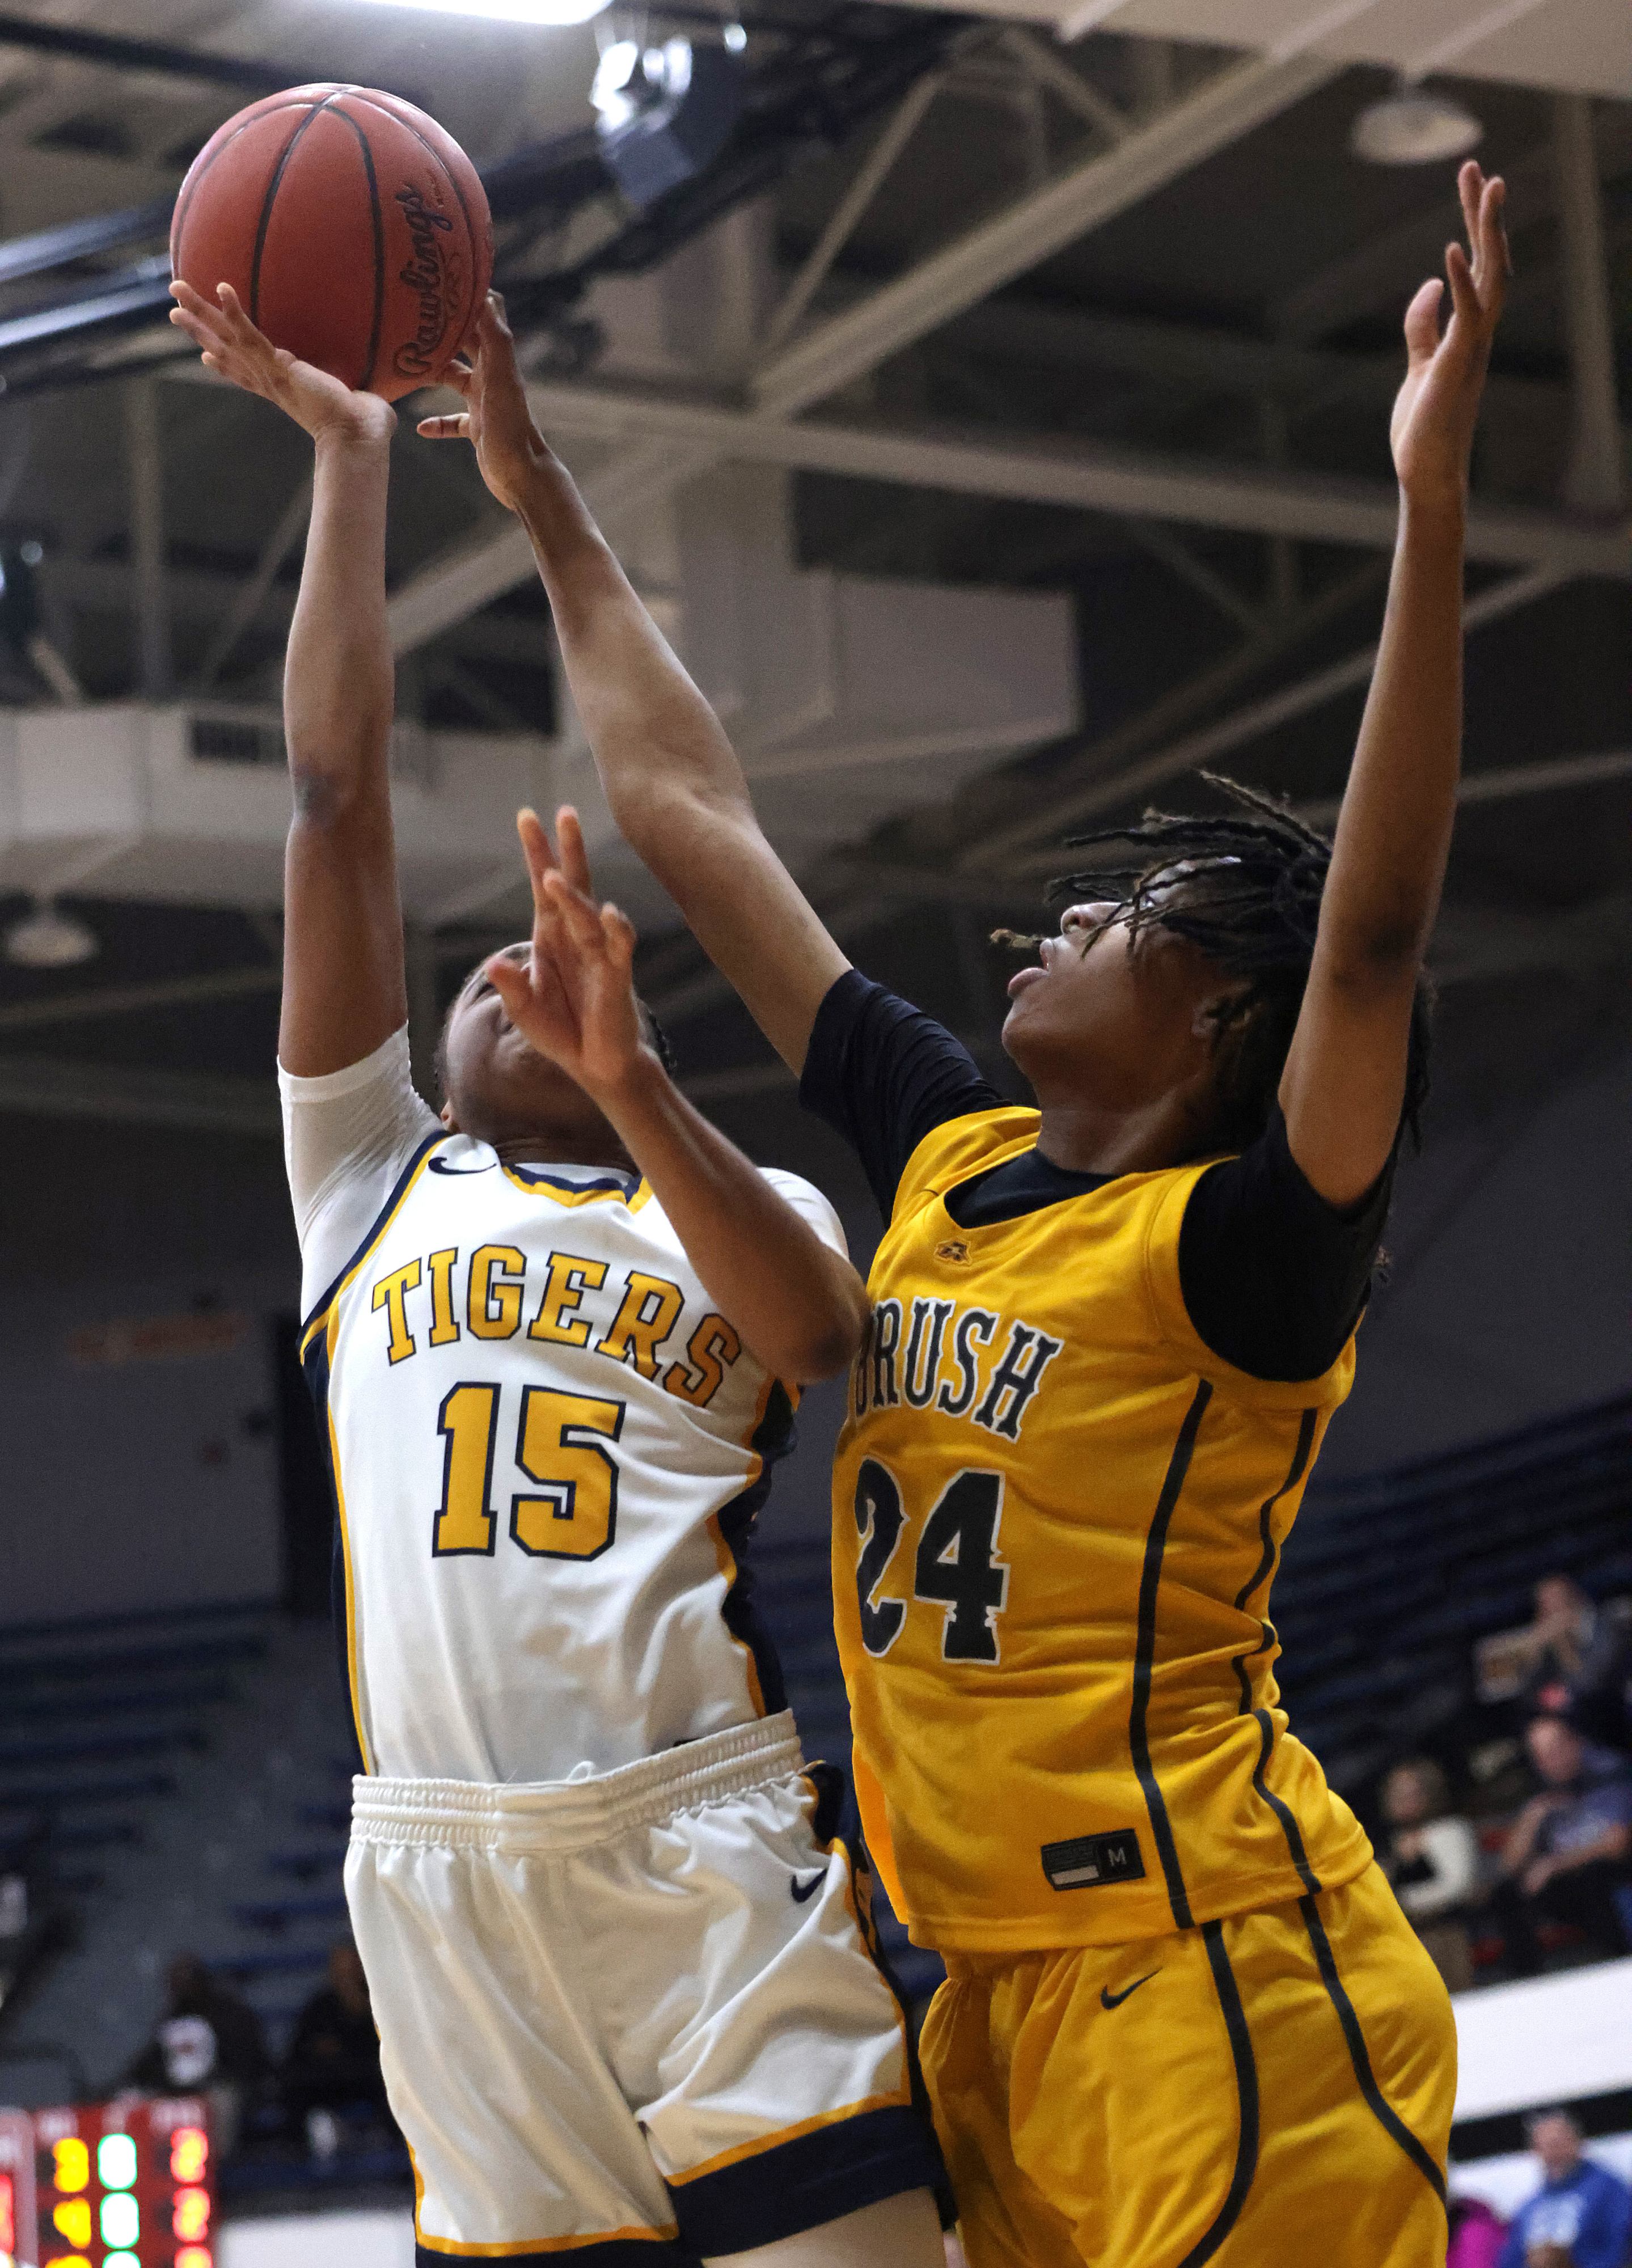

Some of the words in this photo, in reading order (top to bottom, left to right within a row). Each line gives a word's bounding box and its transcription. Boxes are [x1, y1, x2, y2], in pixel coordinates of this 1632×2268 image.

[394, 183, 453, 379] Rawlings
[371, 1244, 742, 1407] TIGERS
[432, 1382, 627, 1562] 15
[854, 1454, 1011, 1666] 24
[1107, 1847, 1127, 1867] M
